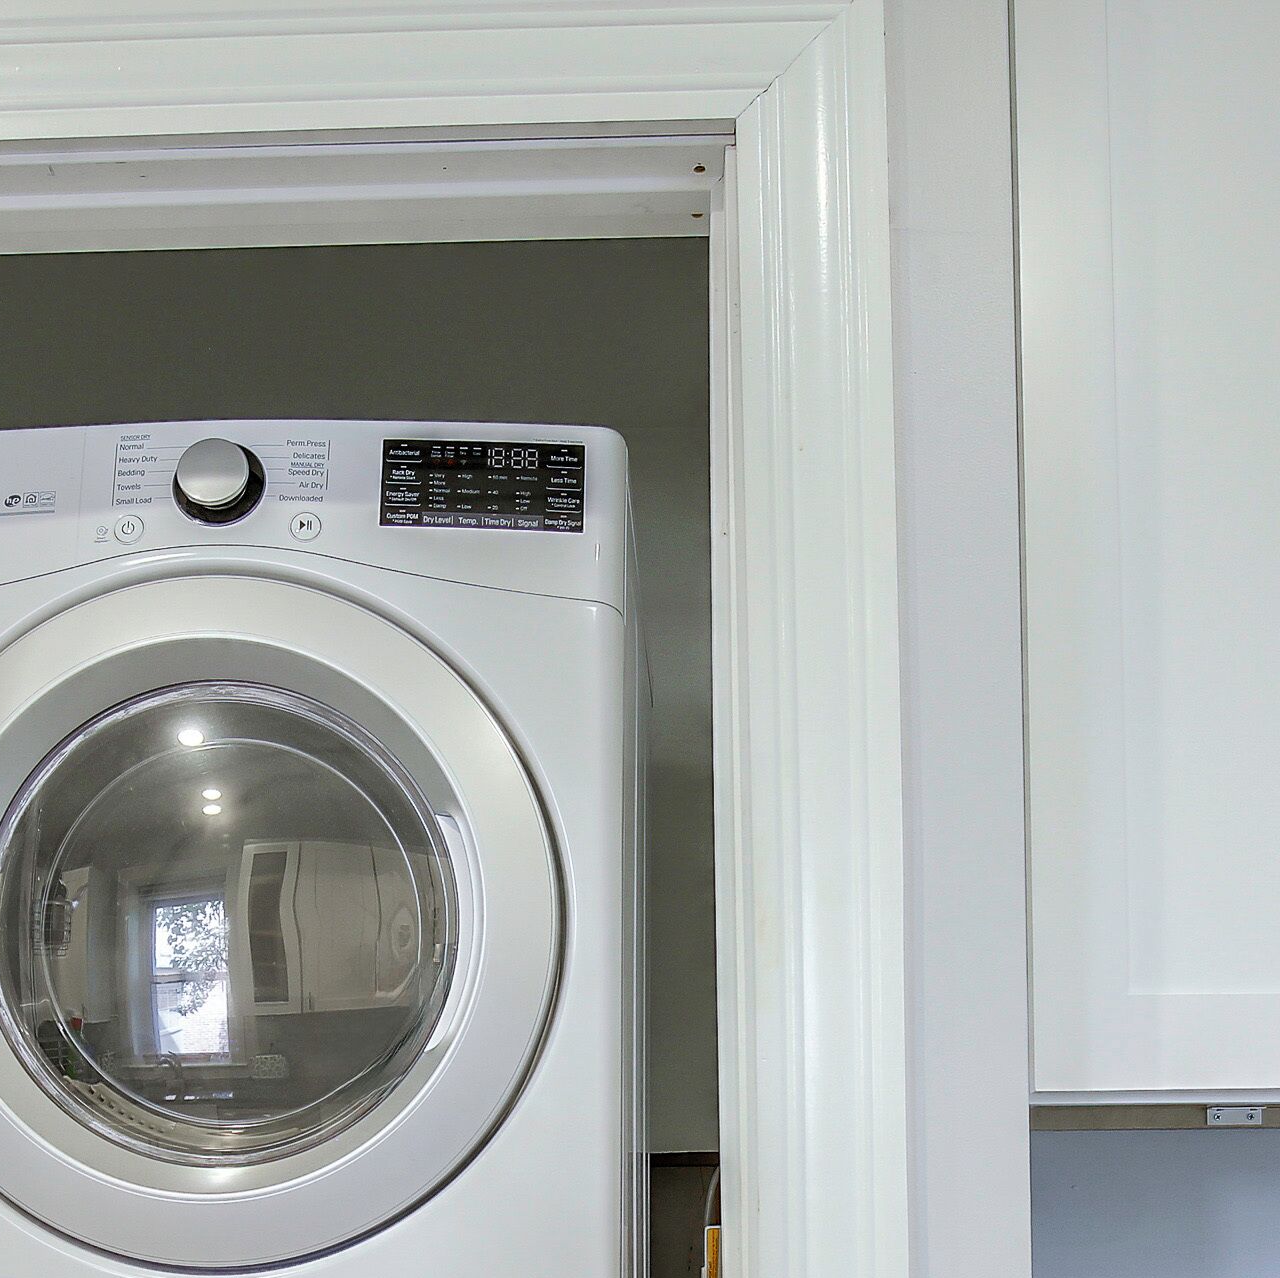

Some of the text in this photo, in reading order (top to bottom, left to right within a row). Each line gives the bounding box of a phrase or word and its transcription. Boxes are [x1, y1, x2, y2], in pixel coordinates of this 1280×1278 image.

[116, 497, 134, 505] Small
[423, 516, 451, 524] Dry Level
[458, 516, 478, 525] Temp.
[500, 519, 511, 527] Dry
